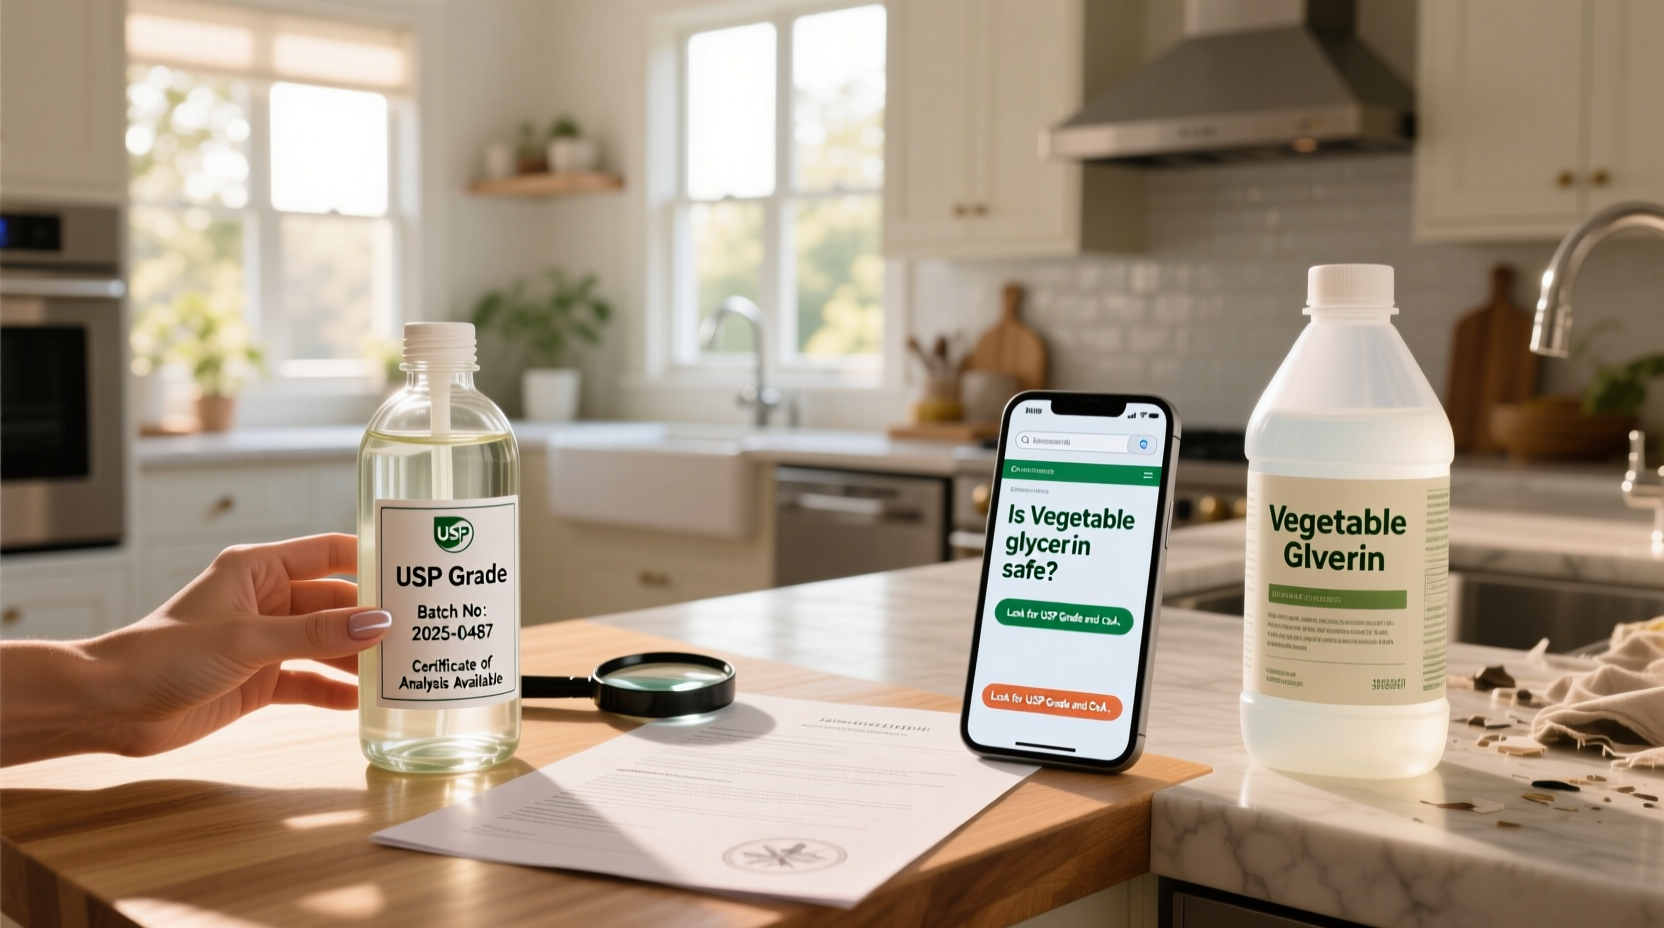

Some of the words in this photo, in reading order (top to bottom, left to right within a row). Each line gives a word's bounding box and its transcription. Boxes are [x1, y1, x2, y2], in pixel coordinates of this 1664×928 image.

[1008, 504, 1025, 524] Is
[1031, 505, 1135, 532] Vegetable
[1269, 504, 1407, 540] Vegetable
[437, 526, 470, 542] USP
[1005, 531, 1091, 557] glycerin
[1284, 541, 1385, 571] Glverin
[396, 566, 443, 587] USP
[448, 562, 508, 586] Grade
[1002, 559, 1058, 581] safe?
[418, 604, 458, 619] Batch
[462, 603, 487, 618] No:
[412, 623, 494, 641] 2025-0487
[412, 658, 477, 673] Certificate
[481, 654, 493, 670] of
[399, 675, 449, 693] Analysis
[453, 672, 503, 690] Available
[1071, 700, 1088, 711] and
